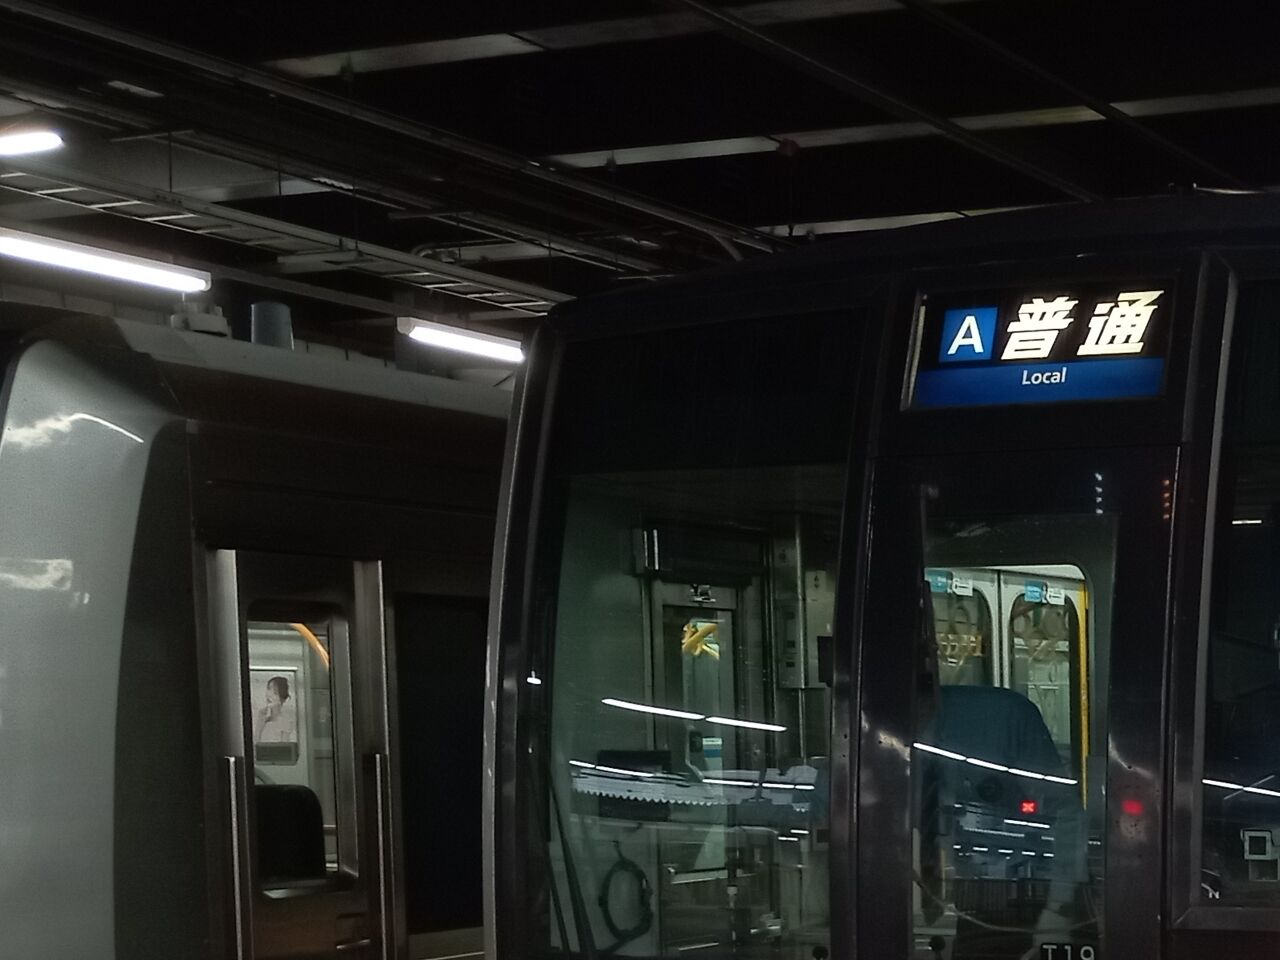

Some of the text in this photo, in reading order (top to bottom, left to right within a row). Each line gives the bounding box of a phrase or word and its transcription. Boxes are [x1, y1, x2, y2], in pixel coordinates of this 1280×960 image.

[947, 315, 983, 355] A
[1001, 290, 1164, 360] 普通
[1022, 367, 1067, 385] Local
